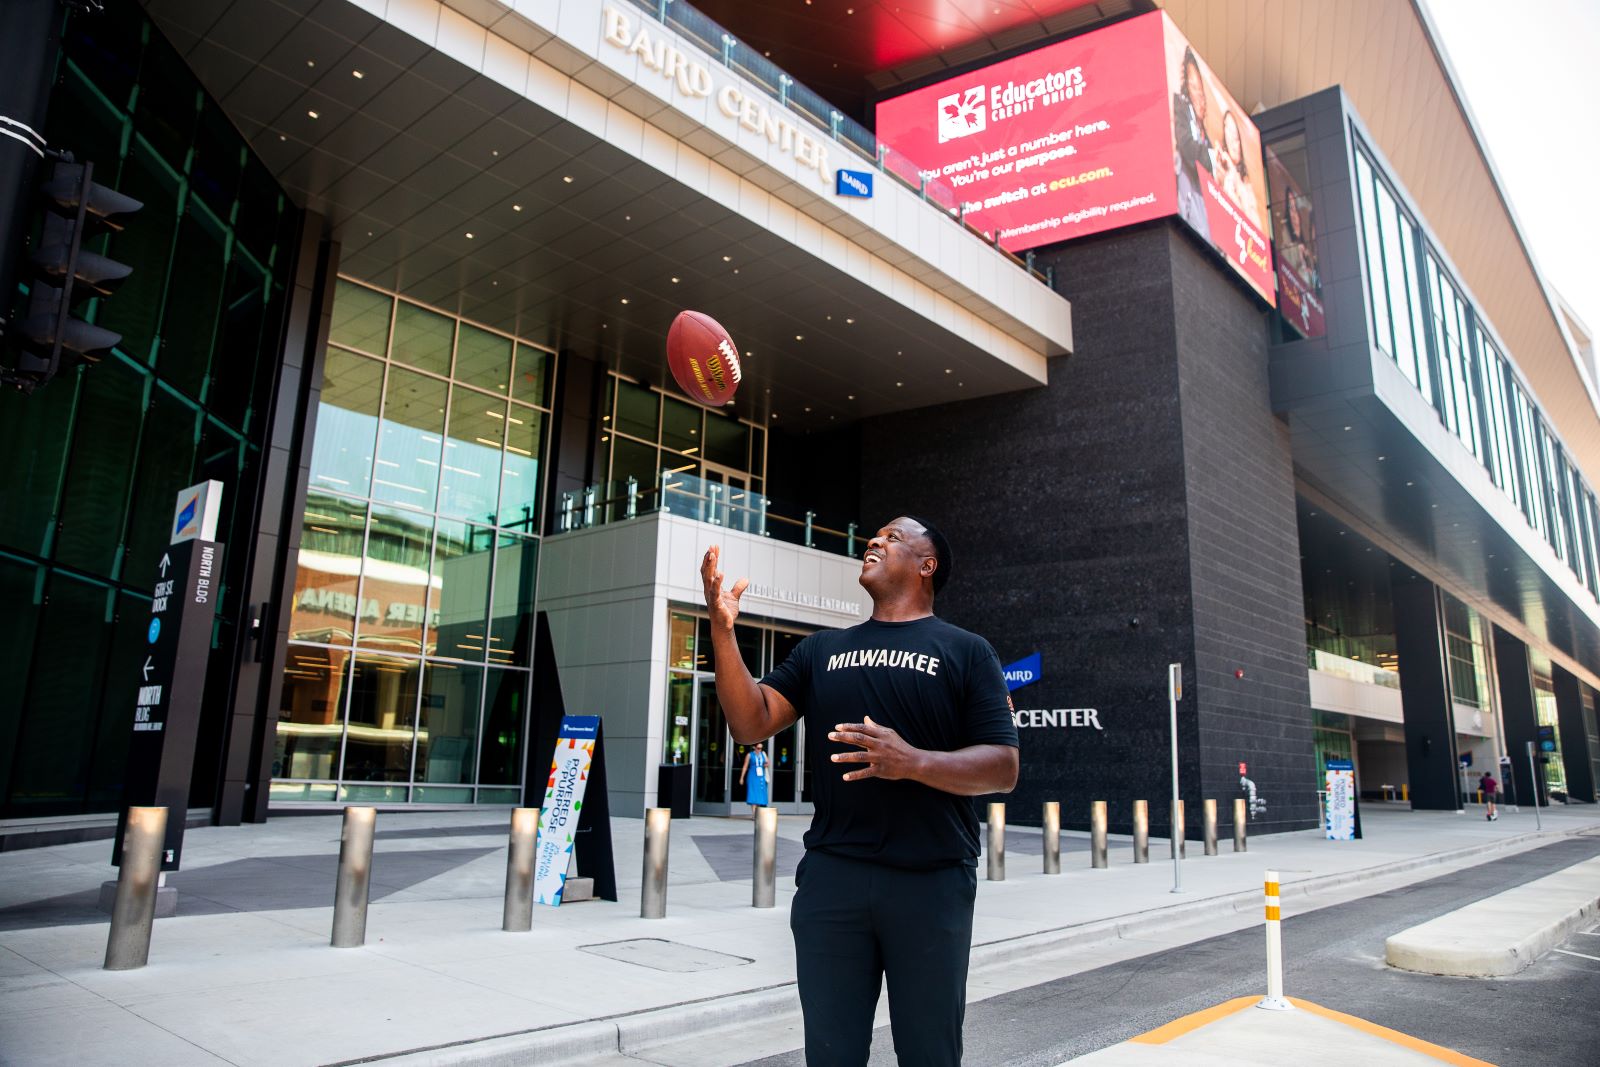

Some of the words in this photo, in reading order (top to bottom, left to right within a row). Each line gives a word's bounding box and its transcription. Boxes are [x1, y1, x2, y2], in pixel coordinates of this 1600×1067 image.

[605, 6, 713, 97] BAIRD
[717, 85, 832, 184] CENTER
[991, 66, 1083, 110] Educators
[991, 98, 1035, 122] CREDIT
[1042, 83, 1084, 106] UNION
[943, 155, 980, 175] aren't
[979, 148, 1006, 167] just
[1007, 145, 1018, 158] a
[1020, 130, 1073, 153] number
[1075, 120, 1110, 137] here.
[950, 169, 989, 187] You're
[991, 161, 1014, 176] our
[1016, 145, 1077, 173] purpose.
[841, 170, 869, 195] BAIRD
[984, 187, 1028, 208] switch
[1031, 182, 1047, 196] at
[1000, 217, 1061, 239] Membership
[1062, 204, 1108, 223] eligibility
[1110, 192, 1156, 213] required.
[199, 546, 214, 577] NORTH
[152, 596, 168, 613] DOCK
[195, 578, 210, 603] BLDG
[820, 596, 860, 616] ENTRANCE
[826, 648, 940, 677] MILWAUKEE
[137, 685, 162, 706] NORTH
[134, 706, 151, 722] BLDG
[1016, 708, 1103, 730] CENTER
[548, 771, 568, 834] PURPOSE
[558, 759, 579, 827] POWERED
